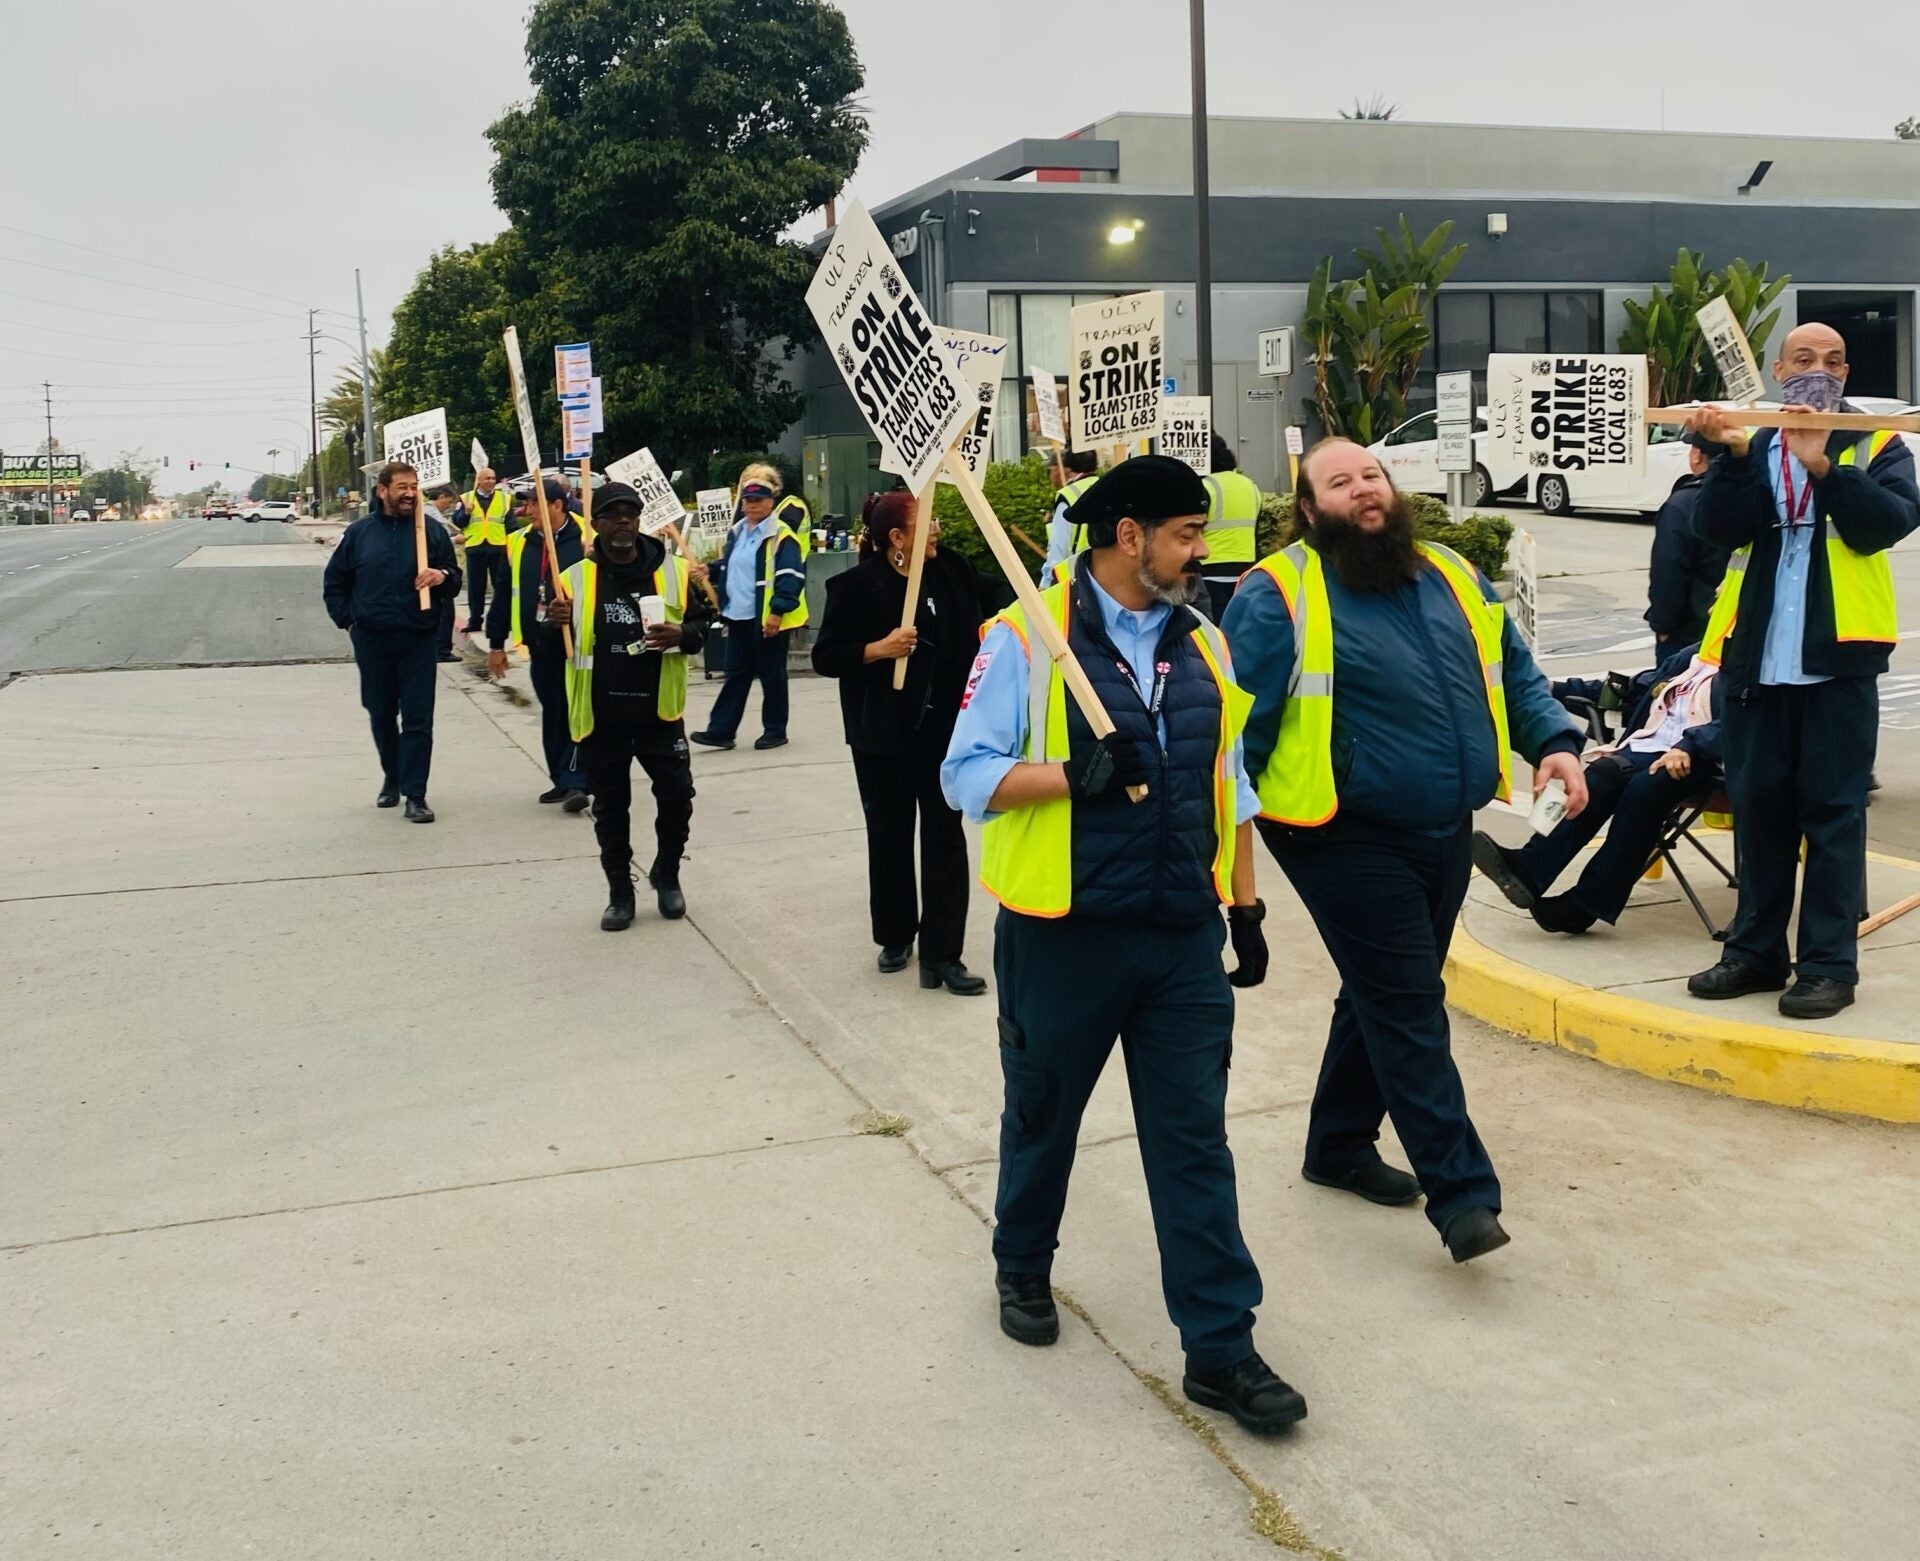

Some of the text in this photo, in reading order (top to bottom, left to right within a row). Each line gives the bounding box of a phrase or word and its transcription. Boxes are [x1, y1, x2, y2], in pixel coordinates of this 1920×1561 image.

[852, 291, 886, 353] ON
[854, 294, 932, 425] STRIKE
[1101, 341, 1138, 366] ON
[1266, 338, 1281, 366] EXIT
[1079, 357, 1161, 404] STRIKE
[879, 345, 943, 445] TEAMSTERS
[1083, 390, 1158, 419] TEAMSTERS
[897, 375, 956, 468] LOCAL 683
[1085, 414, 1126, 436] LOCAL
[1131, 408, 1156, 427] 683
[1173, 420, 1194, 431] ON
[1531, 391, 1550, 440] ON
[1553, 359, 1588, 470] STRIKE
[1588, 363, 1607, 466] TEAMSTERS
[1608, 367, 1626, 464] LOCAL 683
[401, 434, 425, 450] ON
[1162, 432, 1208, 448] STRIKE
[1164, 449, 1206, 458] TEAMSTERS
[3, 457, 35, 470] BUY
[415, 456, 441, 473] STERS
[633, 472, 652, 489] ON
[641, 478, 671, 504] RIKE
[701, 510, 731, 523] STRIKE
